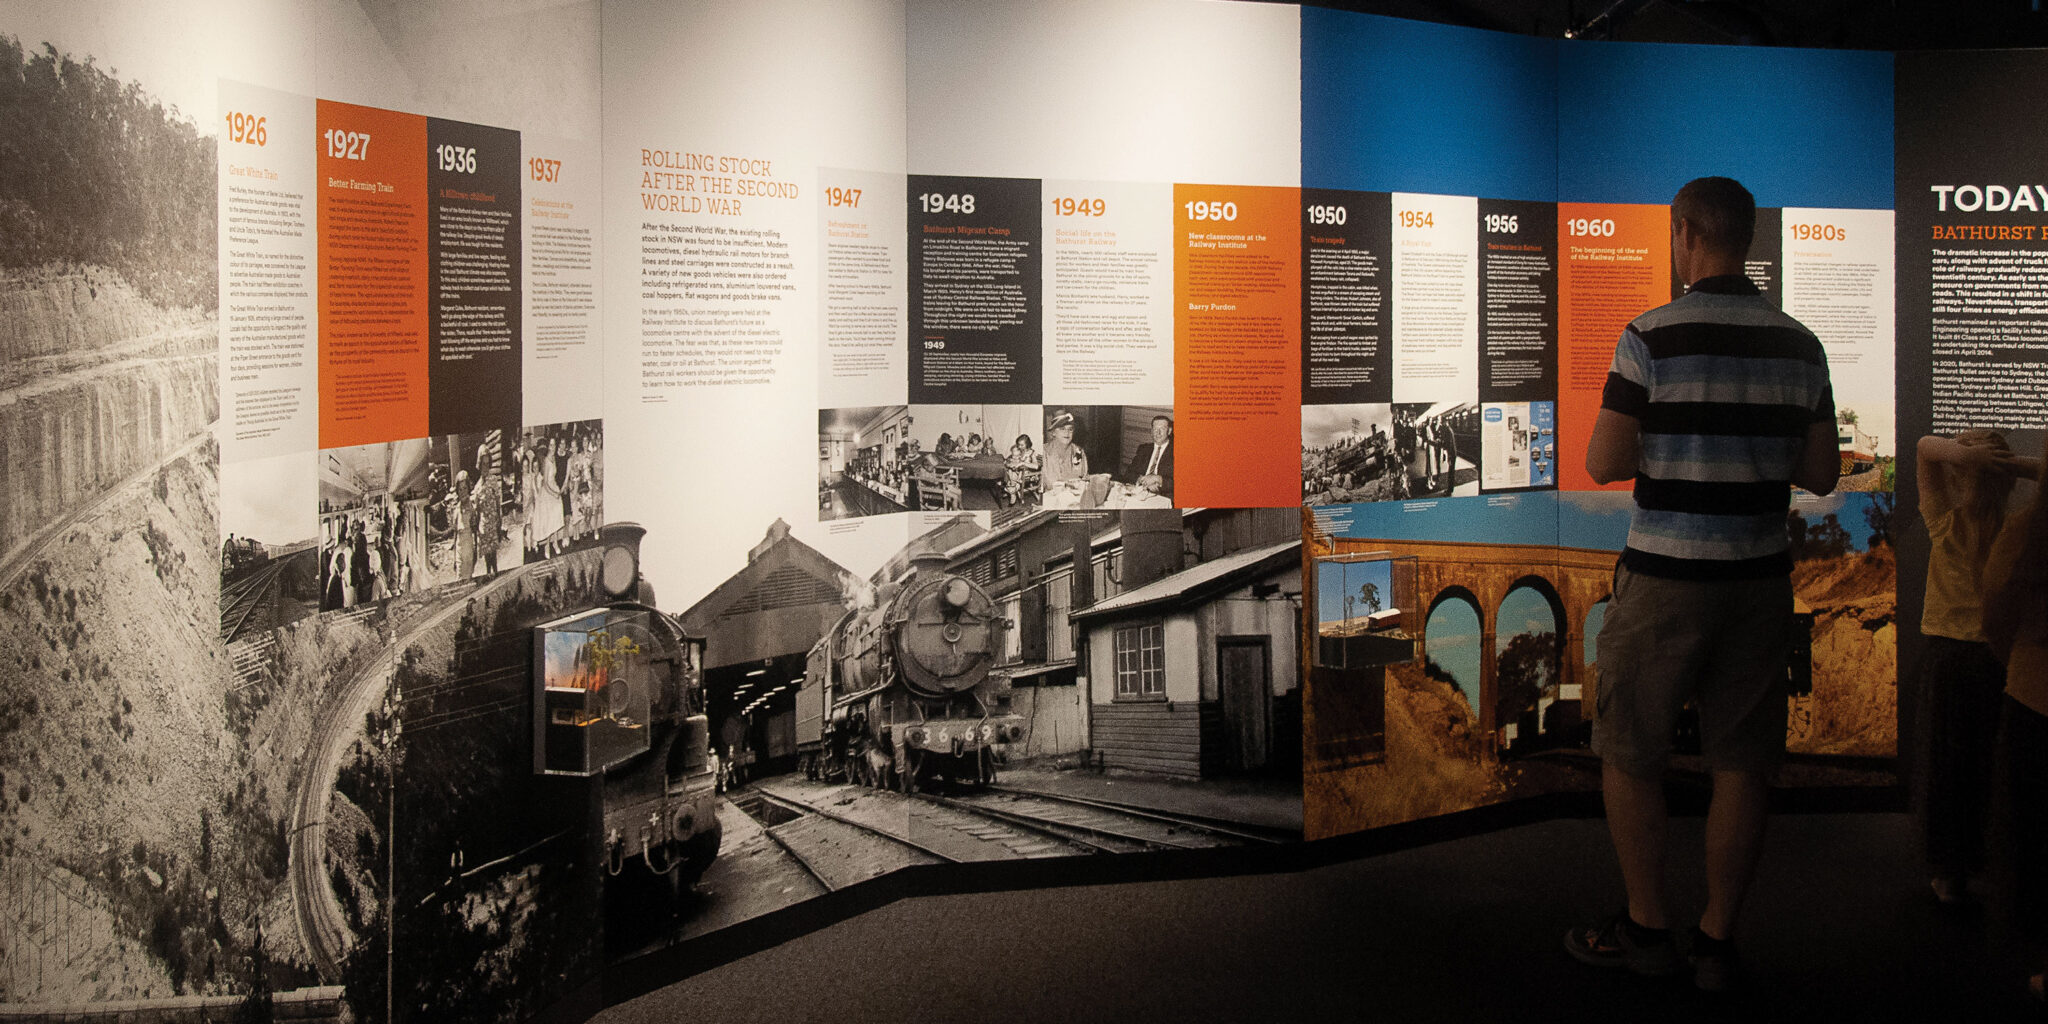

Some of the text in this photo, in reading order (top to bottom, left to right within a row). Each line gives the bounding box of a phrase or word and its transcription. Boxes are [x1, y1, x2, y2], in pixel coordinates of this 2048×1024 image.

[226, 111, 266, 147] 1926
[324, 129, 370, 160] 1927
[436, 144, 476, 174] 1936
[641, 148, 772, 177] ROLLING STOCK
[229, 164, 278, 180] Great White Train
[528, 157, 562, 183] 1937
[328, 177, 394, 194] Better Farming Train
[641, 171, 799, 200] AFTER THE SECOND
[641, 193, 742, 216] WORLD WAR
[824, 187, 862, 208] 1947
[919, 193, 975, 214] 1948
[1931, 185, 2048, 212] TODAY
[1052, 198, 1106, 216] 1949
[1185, 201, 1238, 221] 1950
[1308, 205, 1346, 225] 1950
[1398, 210, 1434, 228] 1954
[1484, 214, 1518, 234] 1956
[642, 222, 658, 231] After
[659, 223, 670, 231] the
[671, 224, 693, 233] Second
[695, 225, 712, 234] World
[715, 226, 728, 235] War,
[739, 228, 761, 239] existing
[763, 228, 780, 239] rolling
[923, 225, 1010, 236] Bathurst Migrant Camp
[1056, 229, 1077, 237] Social
[1080, 229, 1091, 237] life
[1104, 230, 1116, 238] the
[1567, 218, 1615, 237] 1960
[1790, 224, 1846, 241] 1980s
[1932, 225, 2036, 240] BATHURST
[642, 234, 659, 242] stock
[668, 235, 683, 243] NSW
[698, 236, 714, 245] found
[733, 238, 765, 247] insufficient.
[767, 239, 788, 248] Modern
[1088, 238, 1117, 247] Railway
[1188, 232, 1203, 240] New
[1206, 233, 1244, 241] classrooms
[1326, 237, 1346, 245] tragedy
[642, 246, 681, 256] locomotives,
[683, 247, 700, 255] diesel
[702, 248, 728, 258] hydraulic
[741, 249, 760, 257] motors
[771, 250, 789, 258] branch
[1188, 241, 1247, 250] Railway Institute
[1584, 246, 1614, 255] beginning
[1590, 254, 1615, 262] Railway
[1951, 257, 1971, 266] along
[1957, 265, 1986, 274] railways
[1987, 266, 2020, 275] gradually
[1968, 273, 1996, 282] century.
[2008, 274, 2026, 283] early
[1932, 282, 1962, 290] pressure
[1975, 282, 2021, 291] governments
[1189, 303, 1236, 312] Barry Purdon
[1932, 297, 1963, 306] railways.
[1966, 298, 2013, 306] Nevertheless,
[924, 341, 945, 349] 1949
